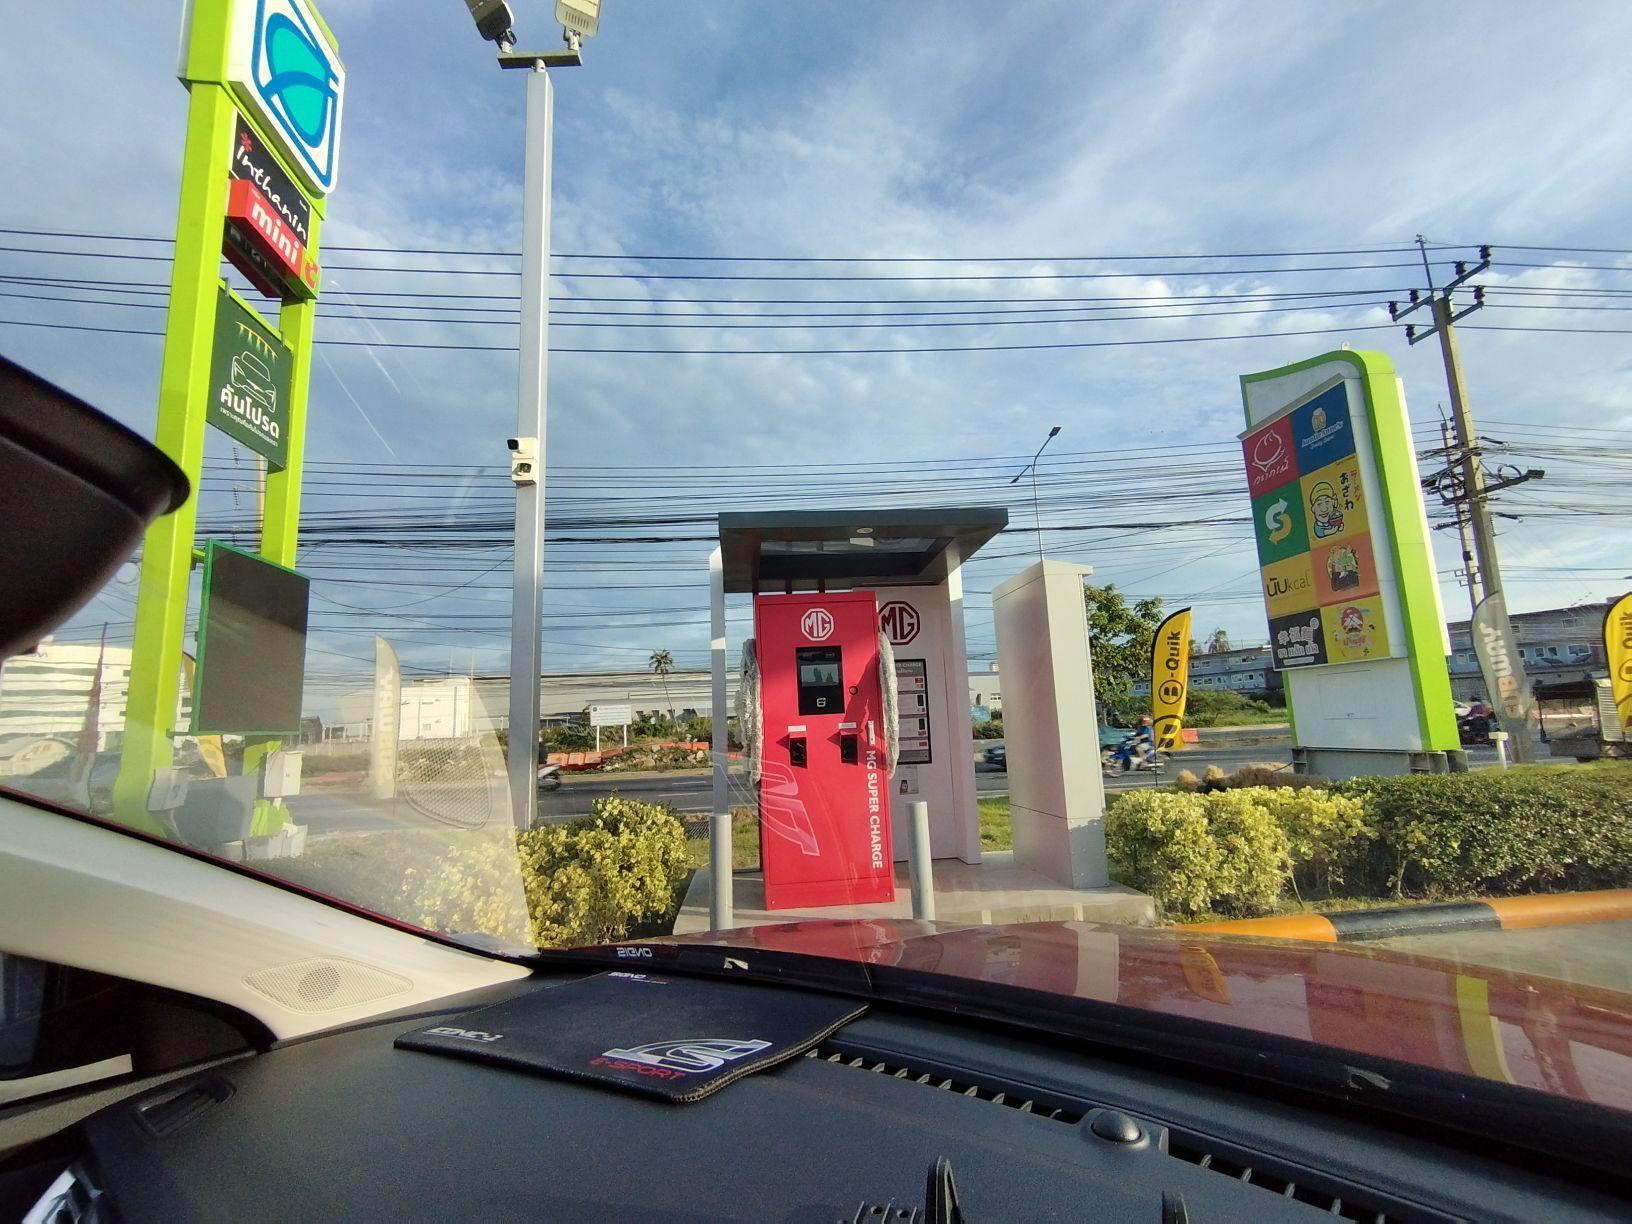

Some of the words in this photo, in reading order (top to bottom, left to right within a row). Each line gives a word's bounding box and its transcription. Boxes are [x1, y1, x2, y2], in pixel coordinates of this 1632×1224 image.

[252, 202, 299, 265] mini
[220, 383, 280, 439] คันโปรด
[1339, 472, 1354, 511] おざわ
[803, 610, 832, 639] MG
[880, 604, 917, 642] MG
[866, 750, 877, 770] MG
[867, 772, 879, 813] SUPER
[869, 815, 883, 869] CHARGE
